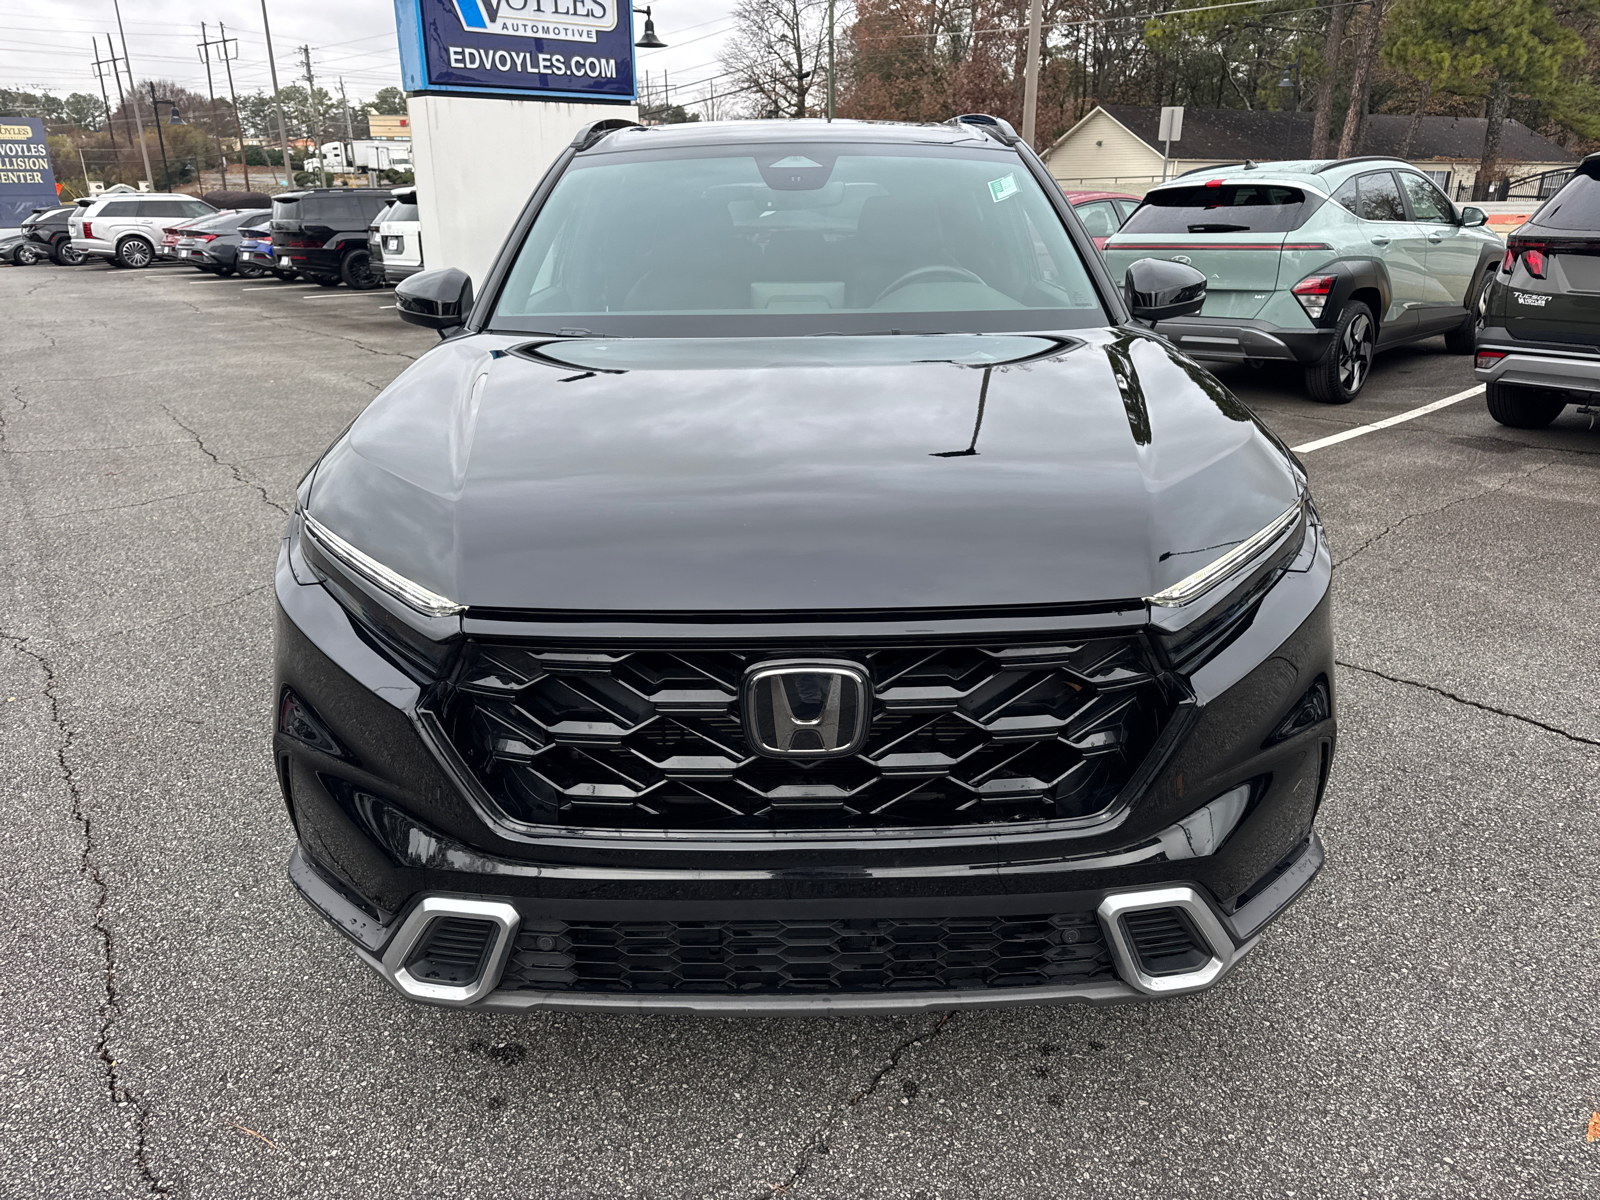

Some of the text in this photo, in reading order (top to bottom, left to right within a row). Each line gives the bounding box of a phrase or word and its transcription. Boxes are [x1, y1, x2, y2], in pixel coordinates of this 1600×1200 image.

[501, 22, 594, 39] AUTOMOTIVE
[449, 46, 617, 78] EDVOYLES.COM
[0, 127, 29, 136] OYLES
[0, 171, 44, 184] ENTER
